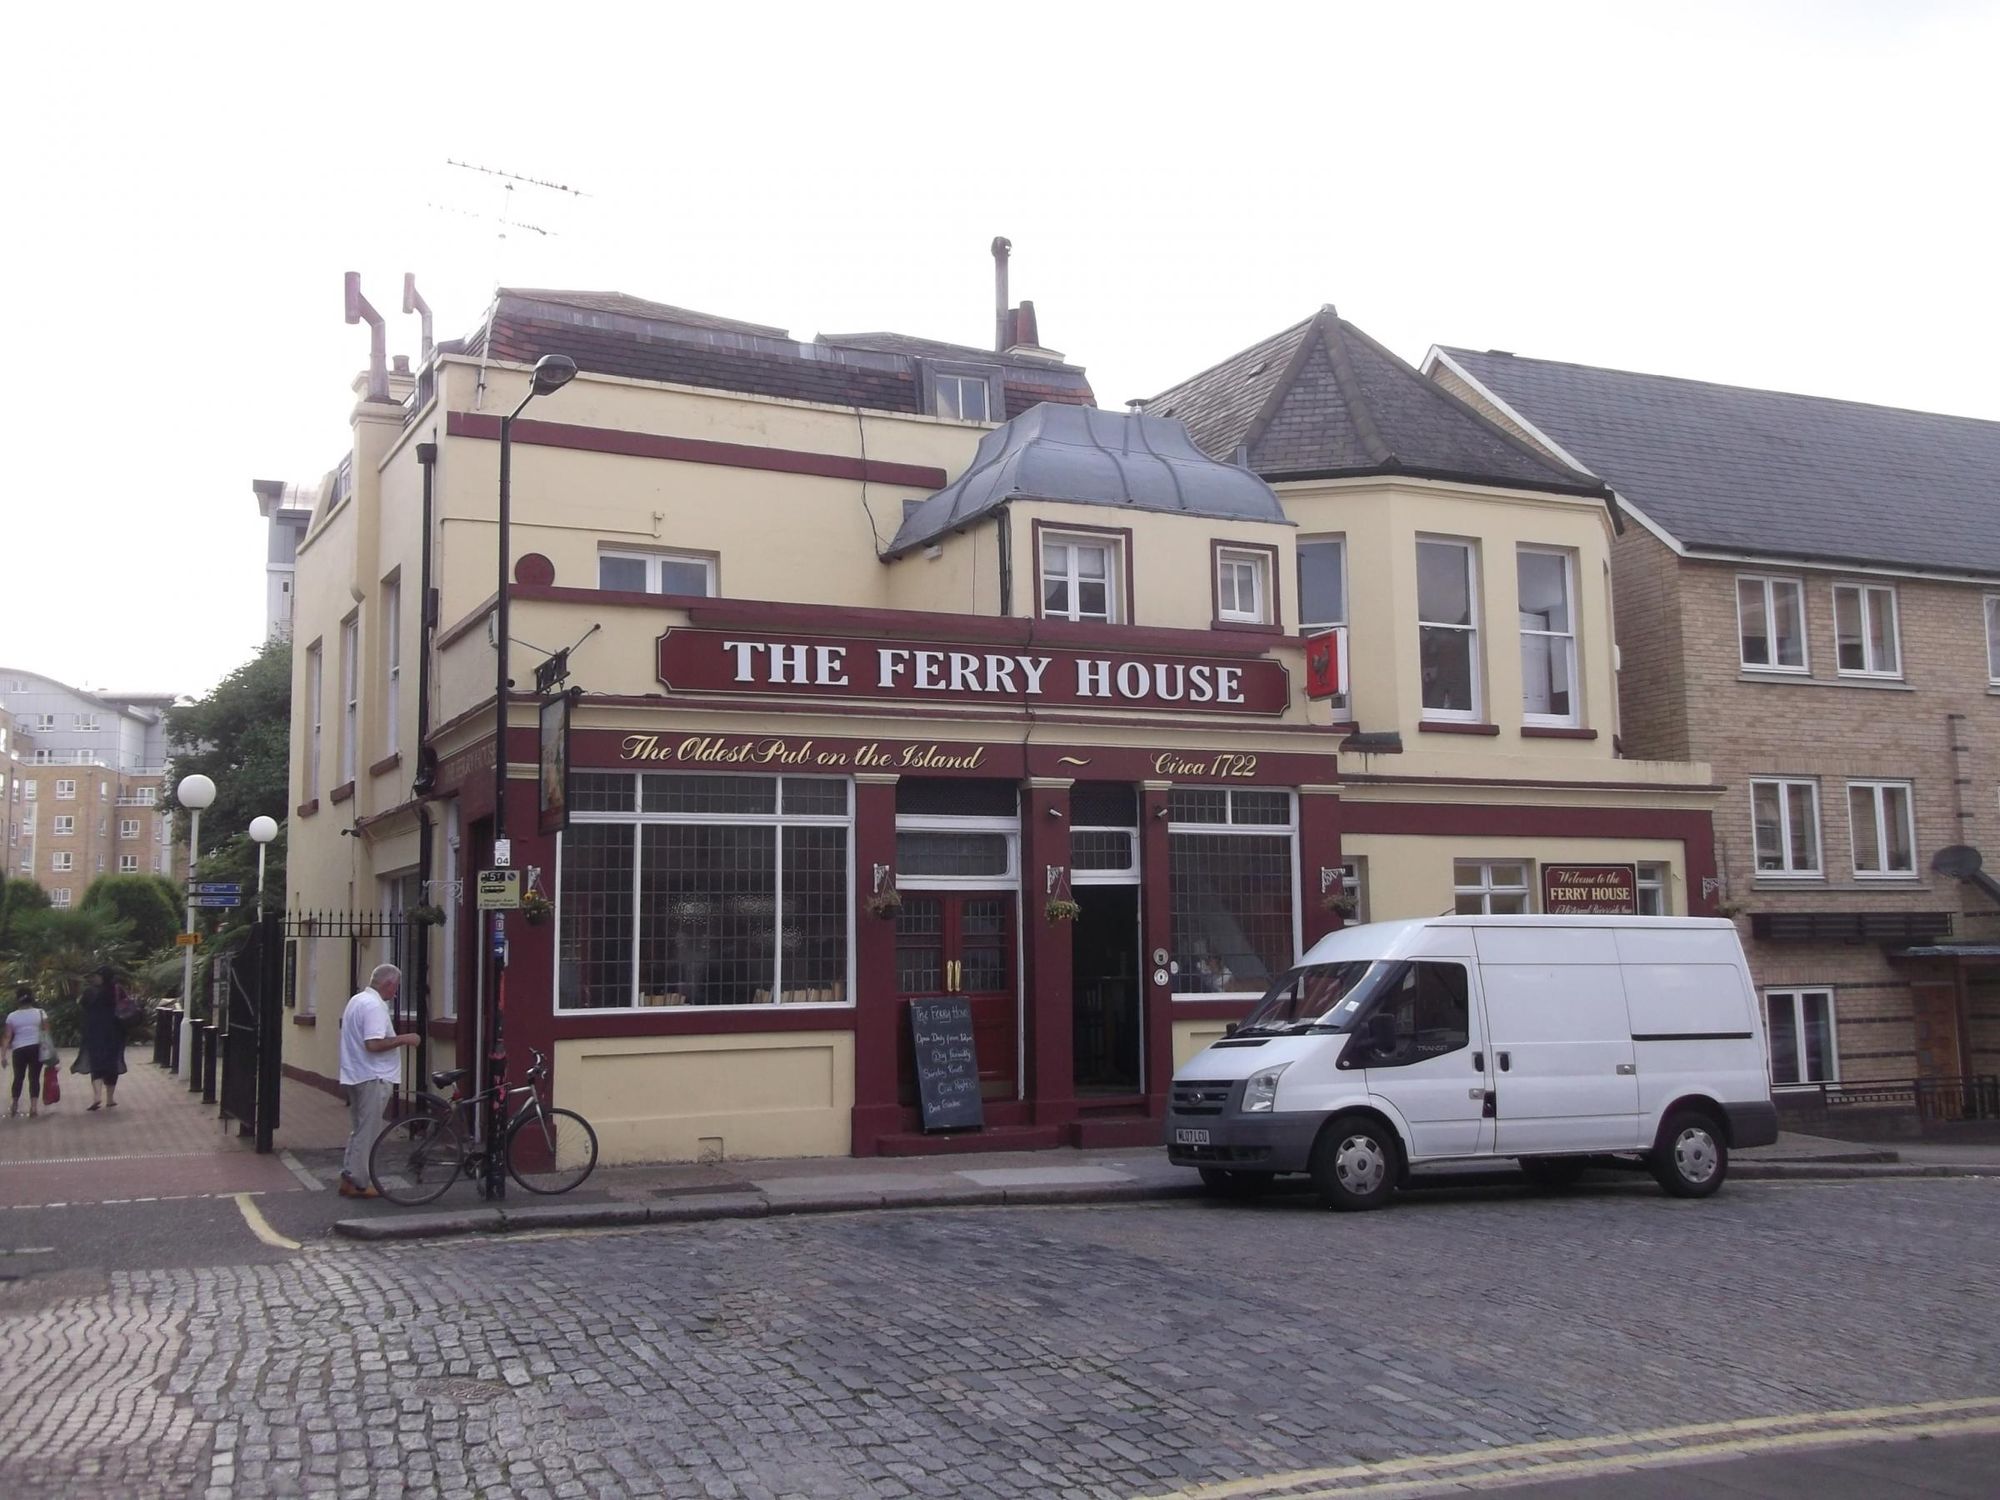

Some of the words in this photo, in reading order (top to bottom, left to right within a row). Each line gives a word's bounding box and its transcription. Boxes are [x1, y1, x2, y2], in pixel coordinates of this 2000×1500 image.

[723, 641, 849, 686] THE
[877, 648, 1052, 694] FERRY
[1075, 659, 1245, 703] HOUSE
[620, 734, 671, 762] The
[676, 736, 752, 763] Oldest
[750, 740, 813, 766] Pub
[817, 752, 850, 766] on
[853, 743, 900, 767] the
[893, 744, 986, 770] Island
[1150, 752, 1207, 776] Circa
[1209, 754, 1257, 778] 1722
[496, 857, 509, 865] 04
[1558, 871, 1594, 884] Welcome
[1596, 873, 1605, 884] to
[1605, 871, 1620, 884] the
[1550, 888, 1588, 900] FERRY
[1592, 888, 1631, 900] HOUSE
[913, 1006, 929, 1020] The
[930, 1005, 951, 1020] Ferry
[916, 1033, 930, 1046] Open
